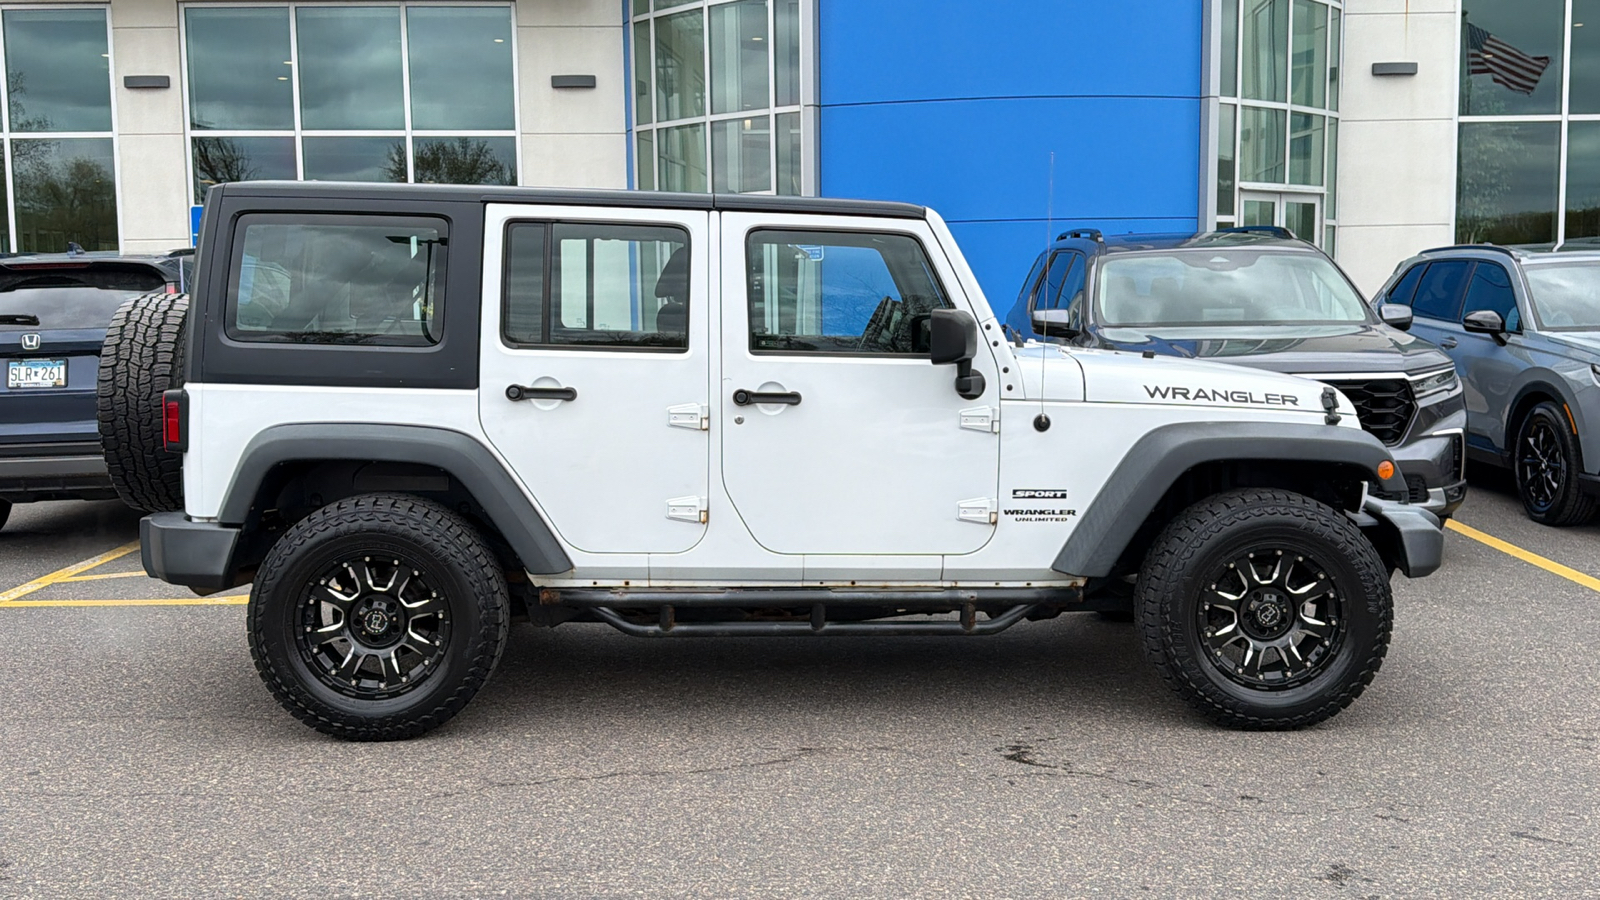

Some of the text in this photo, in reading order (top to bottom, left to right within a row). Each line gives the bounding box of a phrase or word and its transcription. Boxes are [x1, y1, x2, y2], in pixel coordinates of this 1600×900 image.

[11, 366, 62, 381] SLR 261
[1143, 385, 1299, 406] WRANGLER
[1014, 489, 1067, 498] SPORT
